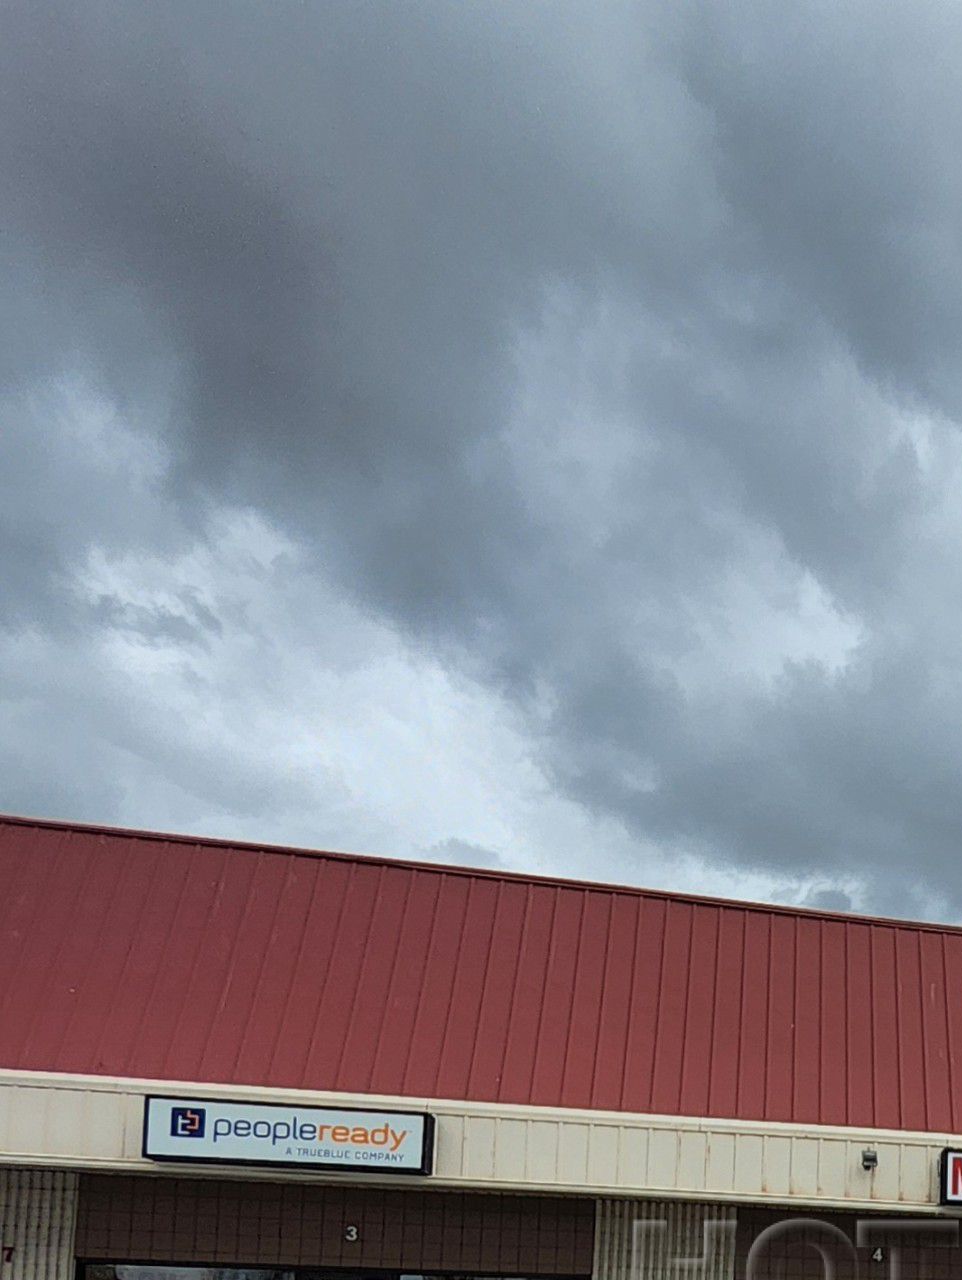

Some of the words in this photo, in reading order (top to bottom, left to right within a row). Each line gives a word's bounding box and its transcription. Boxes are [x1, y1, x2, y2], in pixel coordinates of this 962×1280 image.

[213, 1116, 407, 1151] peopleready
[297, 1148, 350, 1159] TRUEBLUE
[354, 1151, 404, 1162] COMPANY
[345, 1225, 358, 1241] 3
[2, 1246, 15, 1263] 7
[872, 1247, 883, 1262] 4
